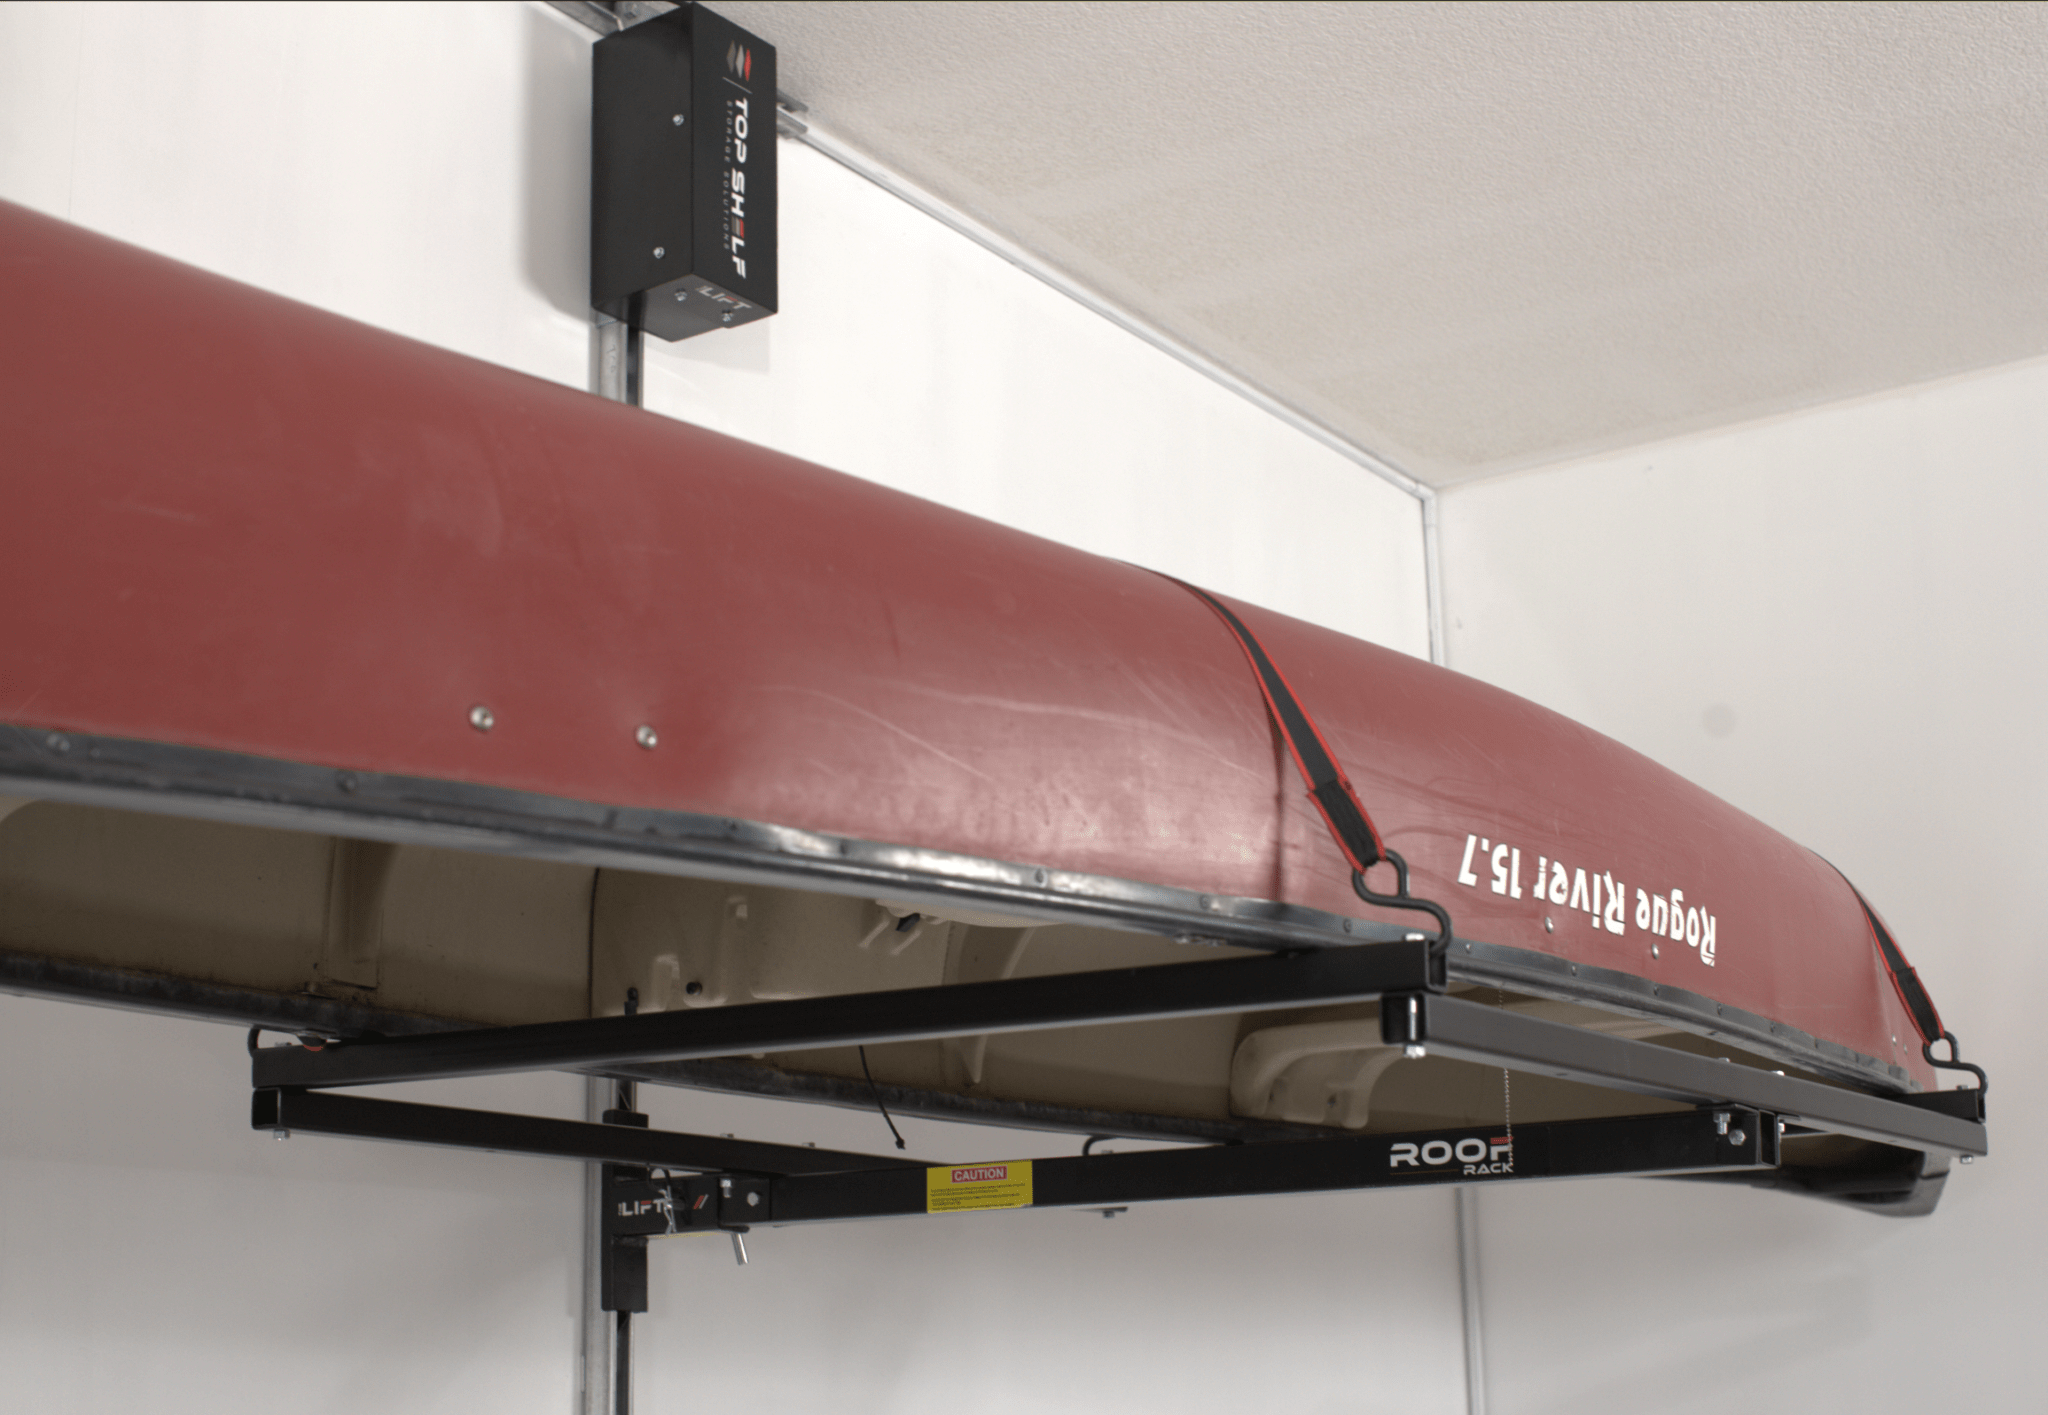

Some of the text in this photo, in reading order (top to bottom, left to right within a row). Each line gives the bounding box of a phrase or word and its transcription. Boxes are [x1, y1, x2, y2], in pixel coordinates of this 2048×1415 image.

[722, 100, 733, 250] STORAGE SOLUTIONS
[731, 97, 748, 279] TOP SHELF
[697, 286, 752, 310] LIFT
[1458, 834, 1717, 967] Rogue River 15.7
[1390, 1136, 1513, 1167] ROOF
[954, 1168, 1005, 1181] CAUTION
[1463, 1162, 1514, 1175] RACK
